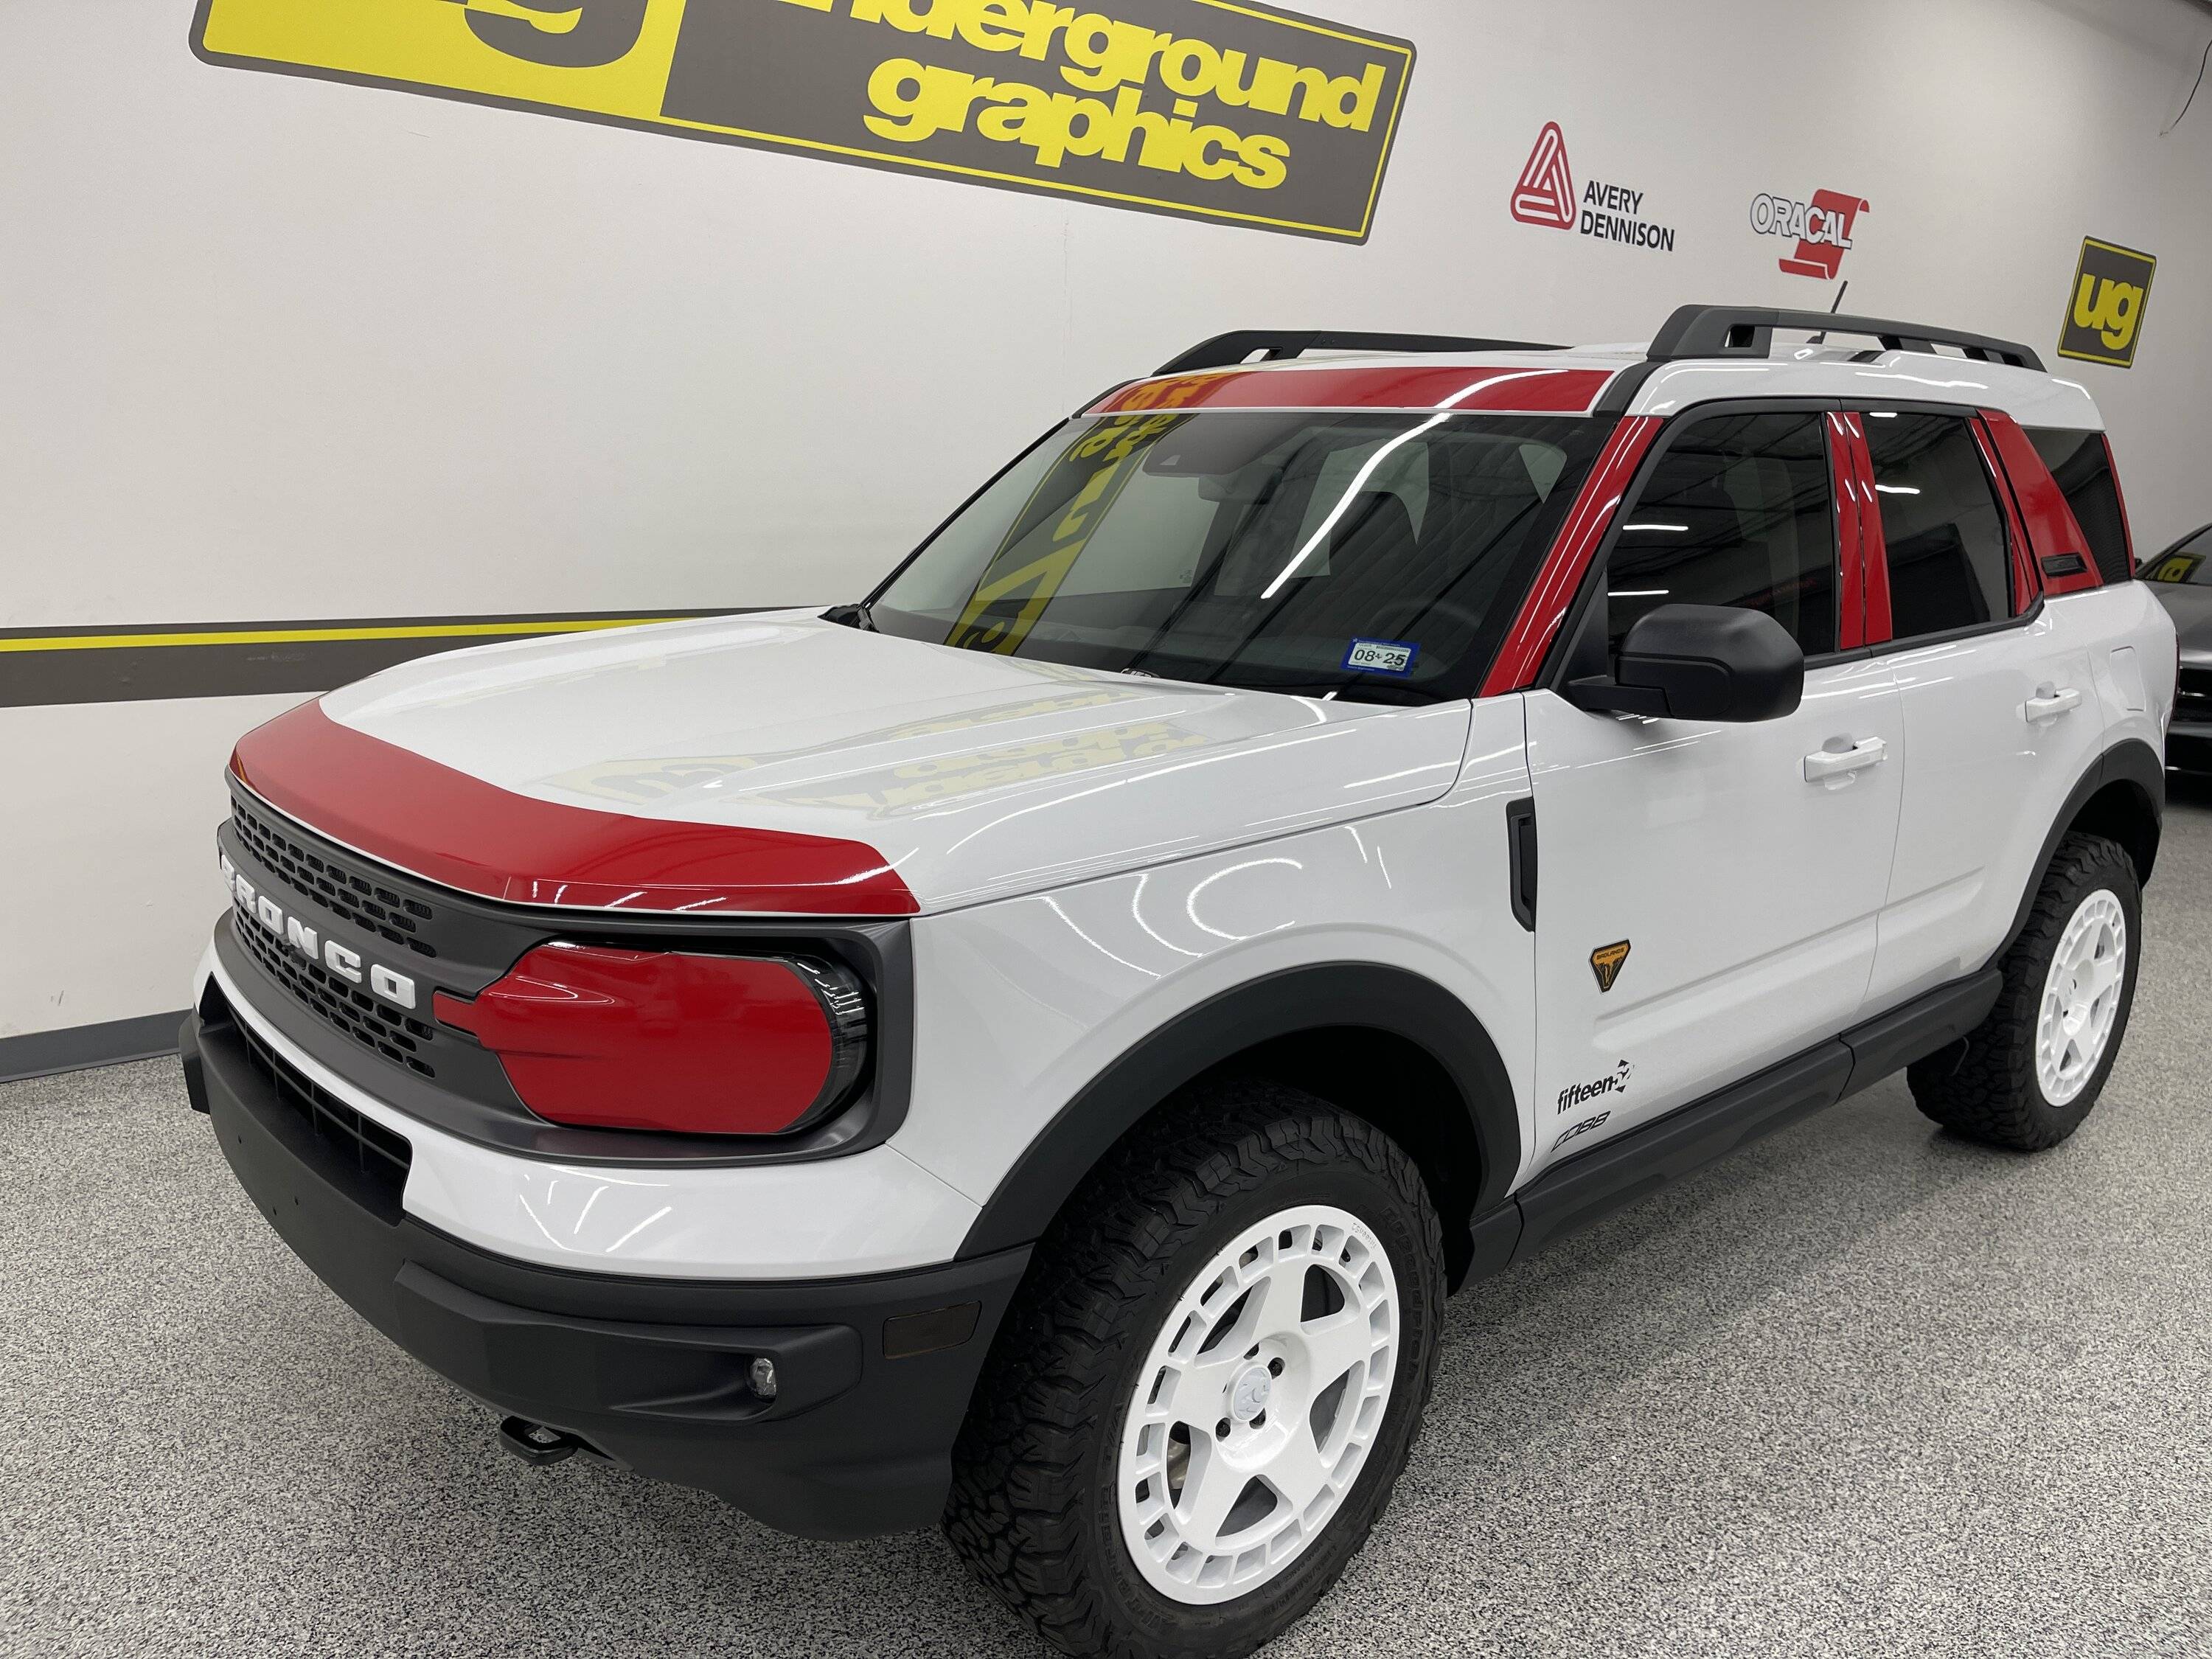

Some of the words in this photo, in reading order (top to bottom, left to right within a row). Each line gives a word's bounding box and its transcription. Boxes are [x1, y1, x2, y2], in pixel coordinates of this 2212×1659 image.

[771, 0, 1385, 133] derground
[863, 58, 1290, 189] graphics
[1580, 209, 1675, 252] DENNISON
[1583, 180, 1644, 215] AVERY
[1750, 193, 1853, 250] ORACAL
[2073, 272, 2143, 350] ug
[1354, 649, 1376, 662] 08
[1382, 653, 1406, 666] 25
[221, 854, 416, 1010] BRONCO
